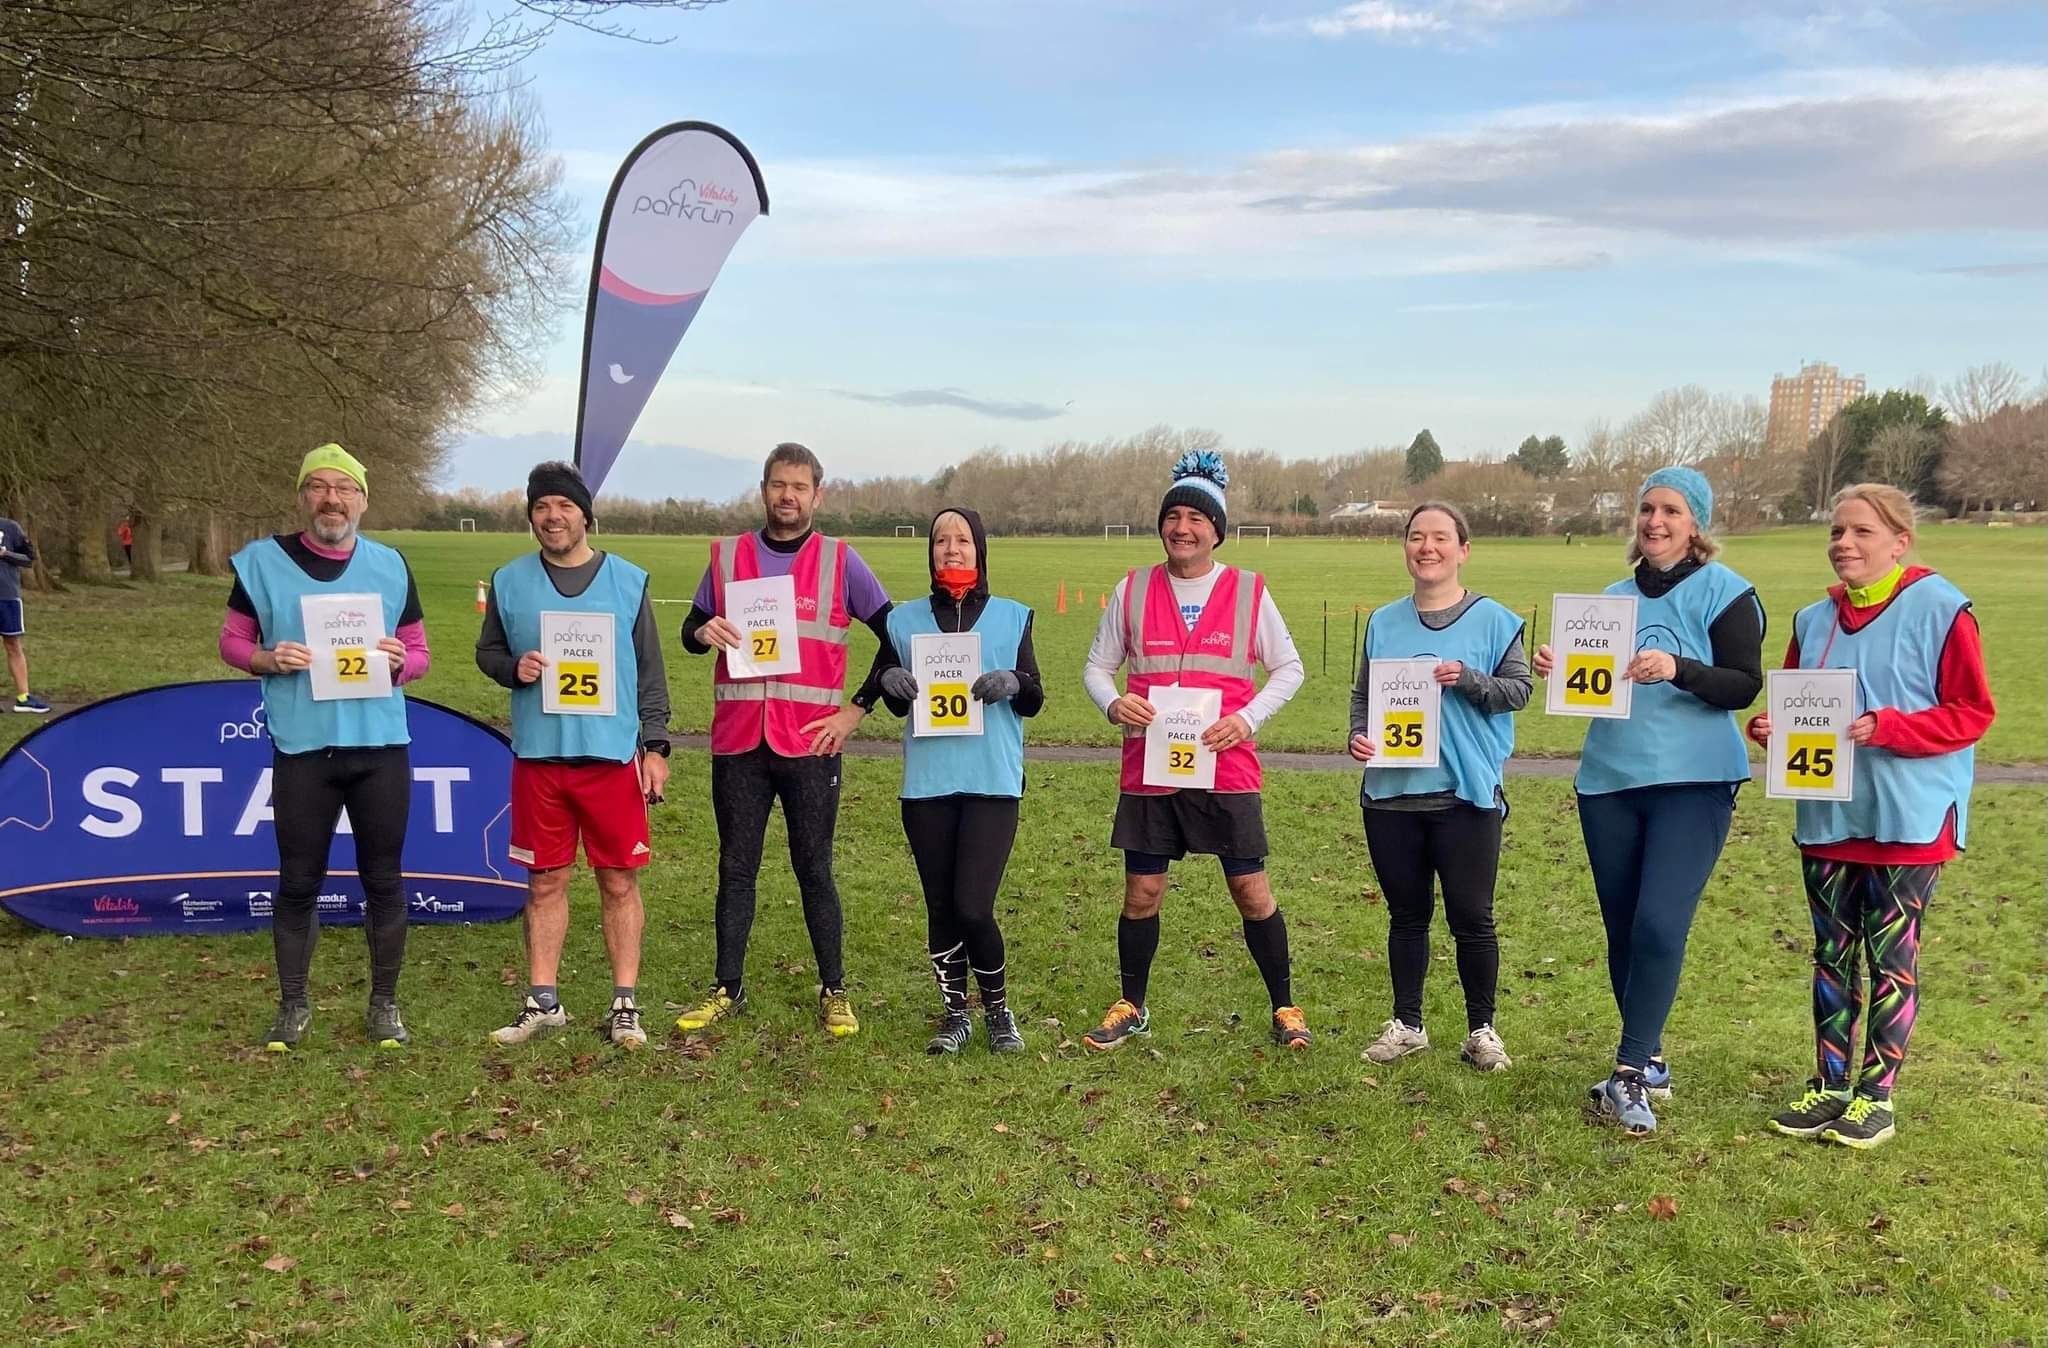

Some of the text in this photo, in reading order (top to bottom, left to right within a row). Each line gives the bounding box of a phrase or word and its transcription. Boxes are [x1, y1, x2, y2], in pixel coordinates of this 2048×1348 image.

[700, 183, 738, 204] Vitality
[632, 191, 735, 225] parkrun
[747, 618, 776, 628] PACER
[1565, 615, 1621, 632] parkrun
[331, 636, 364, 646] PACER
[554, 628, 603, 645] parkrun
[1574, 638, 1609, 648] PACER
[563, 648, 593, 657] PACER
[752, 637, 777, 656] 27
[338, 657, 368, 676] 22
[925, 650, 971, 666] parkrun
[934, 670, 962, 678] PACER
[1566, 667, 1612, 695] 40
[559, 673, 598, 696] 25
[1382, 677, 1429, 692] parkrun
[930, 694, 967, 718] 30
[1390, 697, 1419, 706] PACER
[1784, 692, 1841, 710] parkrun
[1794, 716, 1830, 726] PACER
[1168, 732, 1196, 740] PACER
[1385, 723, 1423, 747] 35
[1169, 751, 1194, 768] 32
[1787, 747, 1833, 777] 45
[79, 766, 471, 838] STAT
[94, 895, 139, 916] Vitality
[433, 901, 464, 913] Persil
